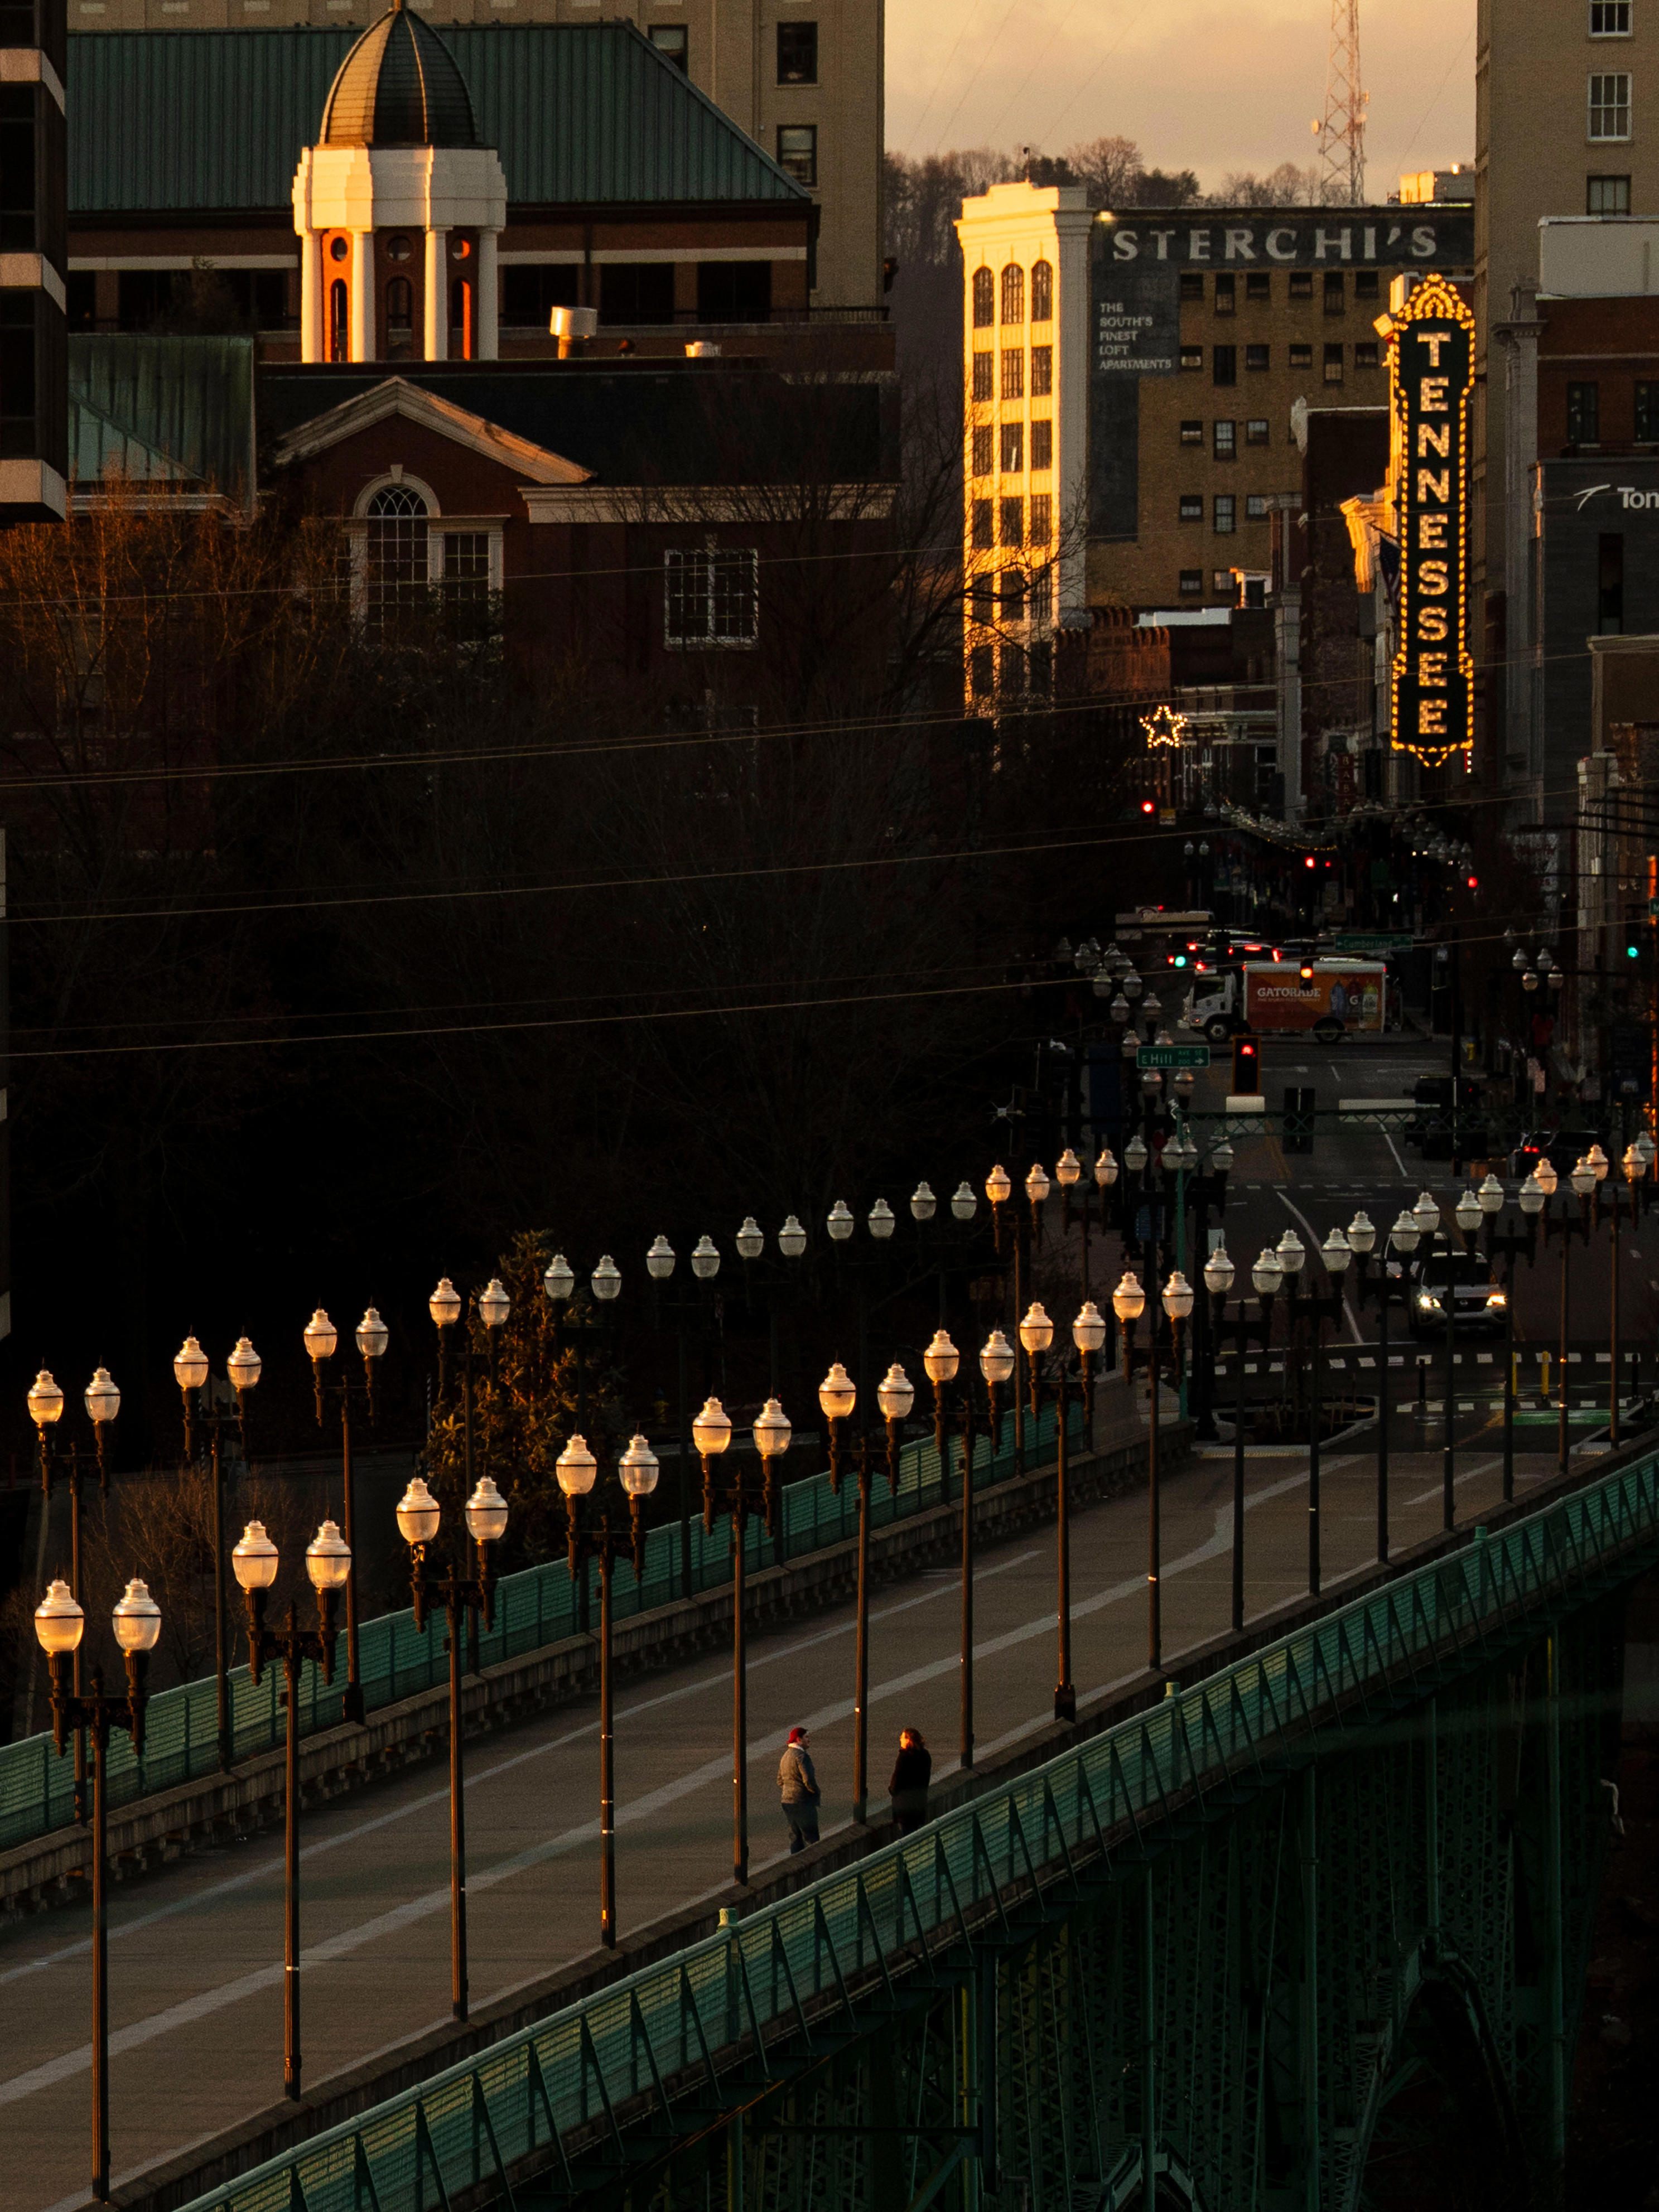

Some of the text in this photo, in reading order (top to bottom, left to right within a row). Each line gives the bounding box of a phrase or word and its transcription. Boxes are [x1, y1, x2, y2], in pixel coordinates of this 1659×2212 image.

[1113, 226, 1438, 260] STERCHI'S
[1099, 302, 1124, 313] THE
[1099, 316, 1153, 327] SOUTH'S
[1099, 331, 1138, 341] FINEST
[1099, 345, 1129, 355] LOFT
[1099, 359, 1171, 370] APARTMENTS
[1417, 332, 1451, 734] TENNESSEE
[1257, 987, 1322, 997] GATORADE
[1141, 1054, 1172, 1064] E Hill
